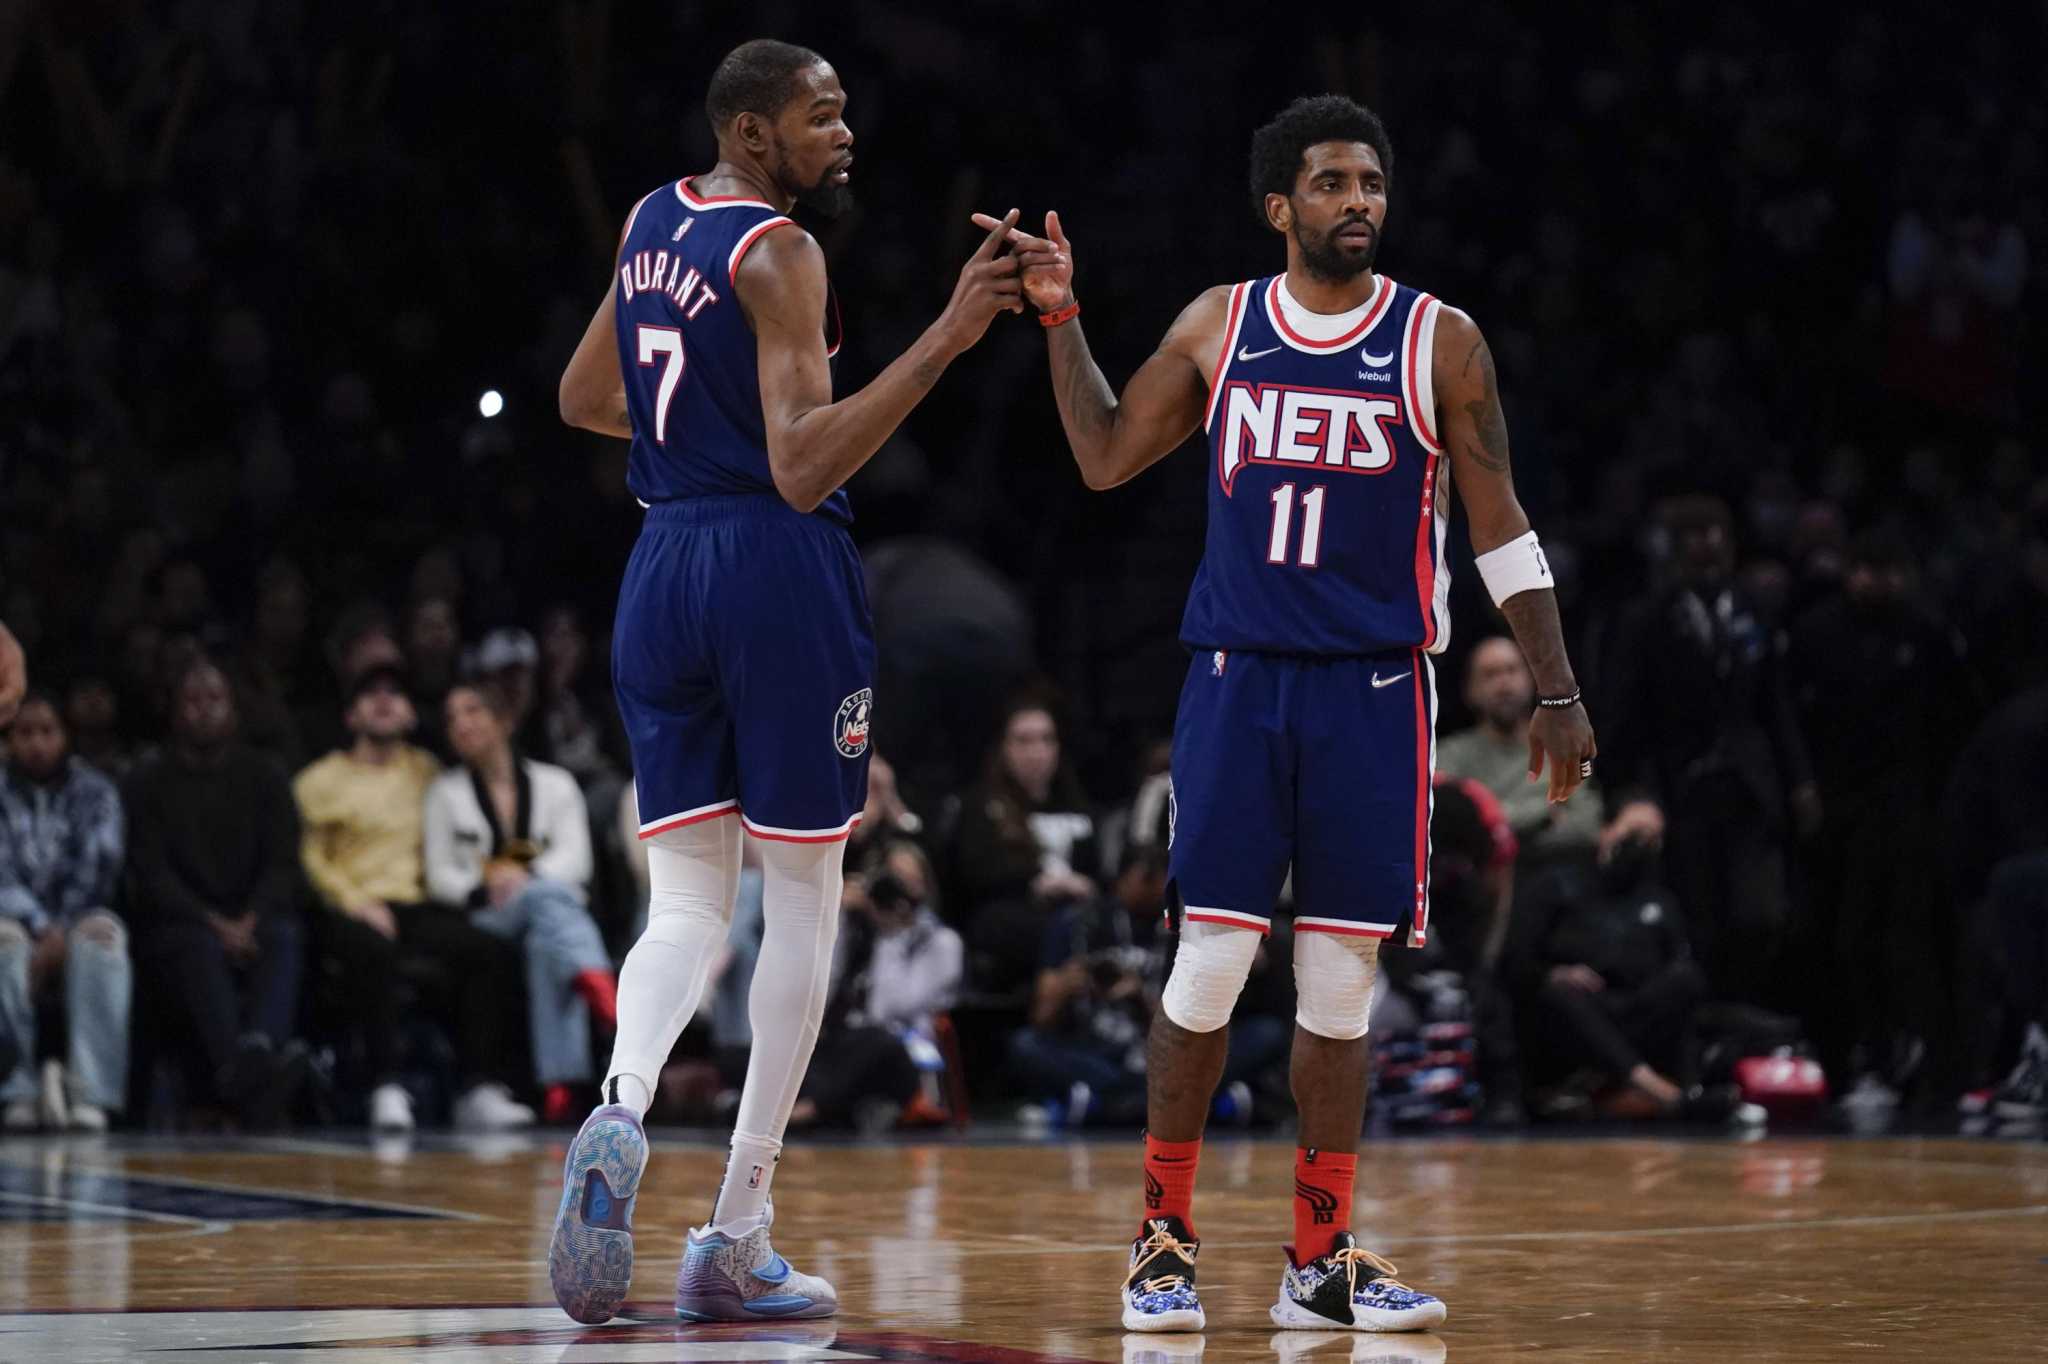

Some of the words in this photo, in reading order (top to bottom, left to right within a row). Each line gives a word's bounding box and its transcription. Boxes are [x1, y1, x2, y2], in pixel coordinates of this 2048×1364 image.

[620, 250, 719, 321] DURANT
[636, 323, 687, 446] 7
[1358, 370, 1391, 382] Webull
[1219, 382, 1401, 492] NETS
[1267, 481, 1327, 568] 11
